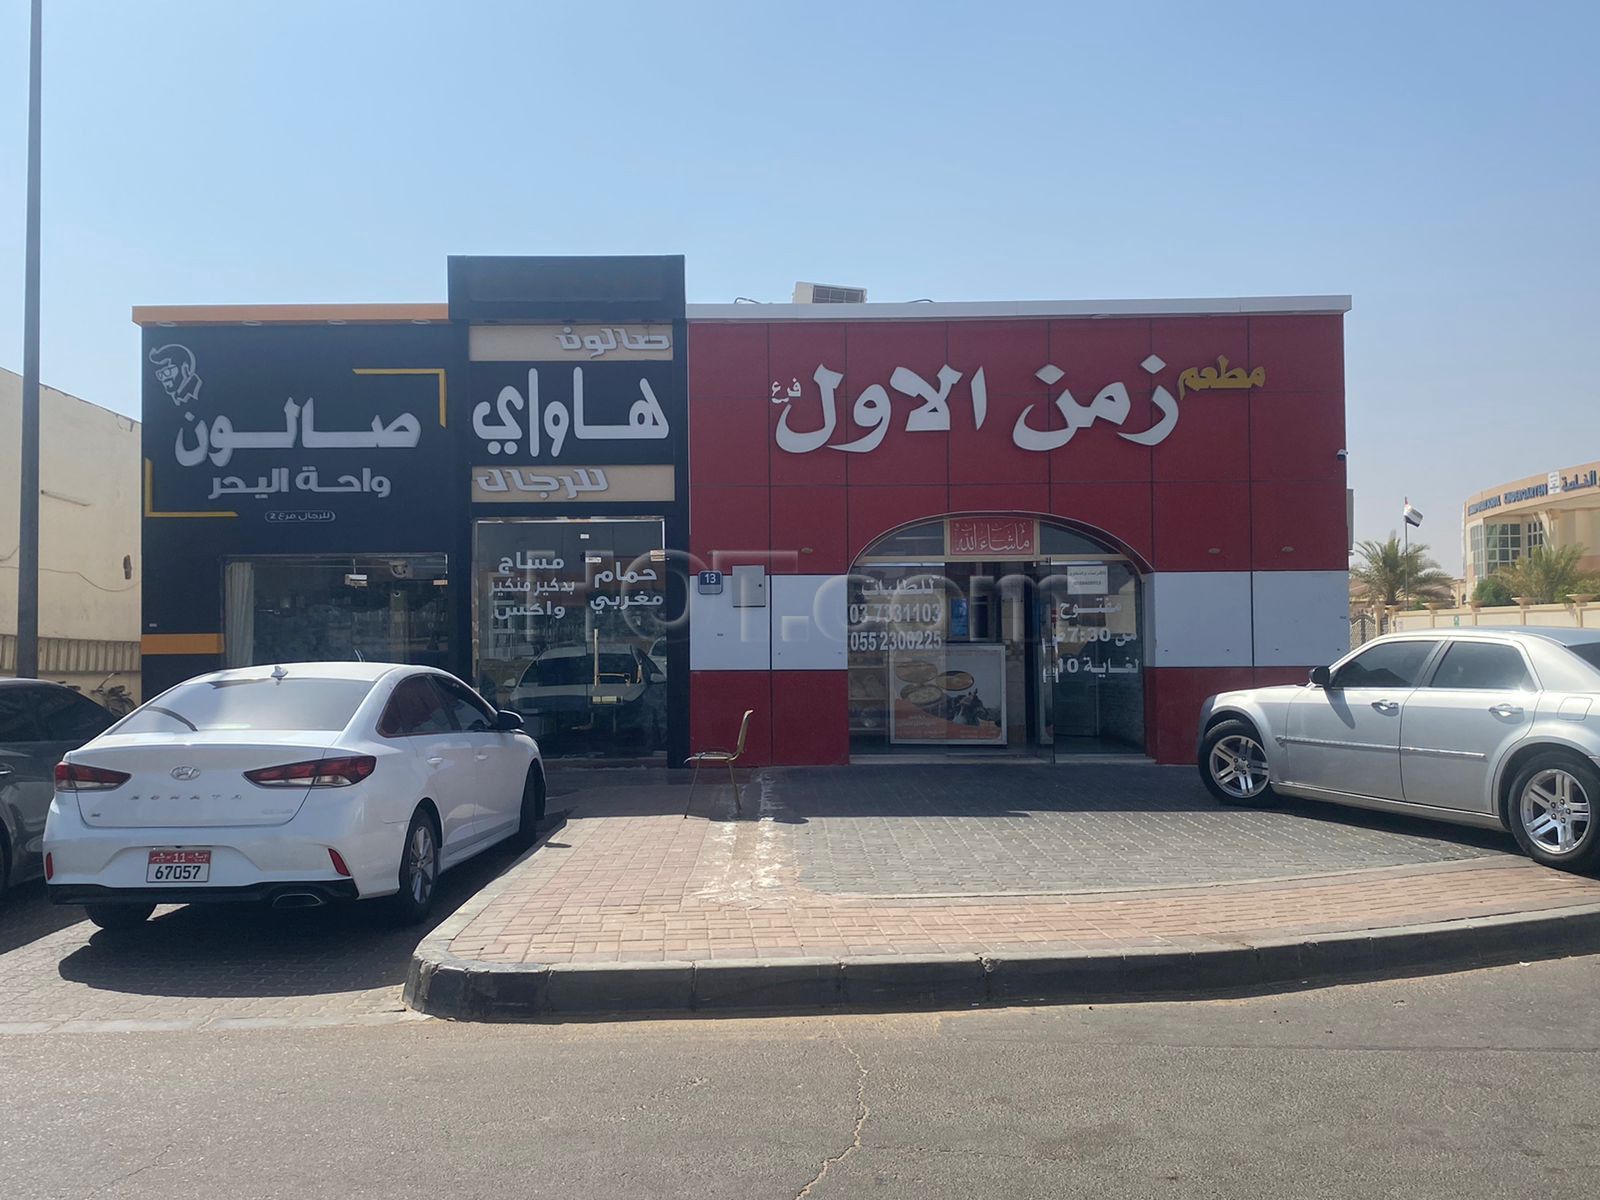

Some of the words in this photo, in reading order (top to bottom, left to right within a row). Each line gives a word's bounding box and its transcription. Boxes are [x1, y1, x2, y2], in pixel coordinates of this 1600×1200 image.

[555, 326, 671, 359] صالون
[1177, 353, 1266, 401] مطعم
[472, 366, 670, 457] هاواي
[775, 363, 987, 453] الاول
[1012, 353, 1180, 452] زمن
[175, 397, 422, 467] صالون
[295, 466, 392, 498] واحة
[476, 468, 609, 499] للرجال
[498, 551, 565, 574] مساج
[594, 561, 657, 588] حمام
[488, 577, 531, 597] منكير
[534, 577, 576, 597] بدكير
[704, 573, 716, 584] 13
[490, 600, 566, 620] واكس
[590, 590, 664, 614] مغربي
[1060, 597, 1122, 619] مفتوح
[1083, 656, 1140, 678] لغاية
[155, 865, 201, 880] 67057
